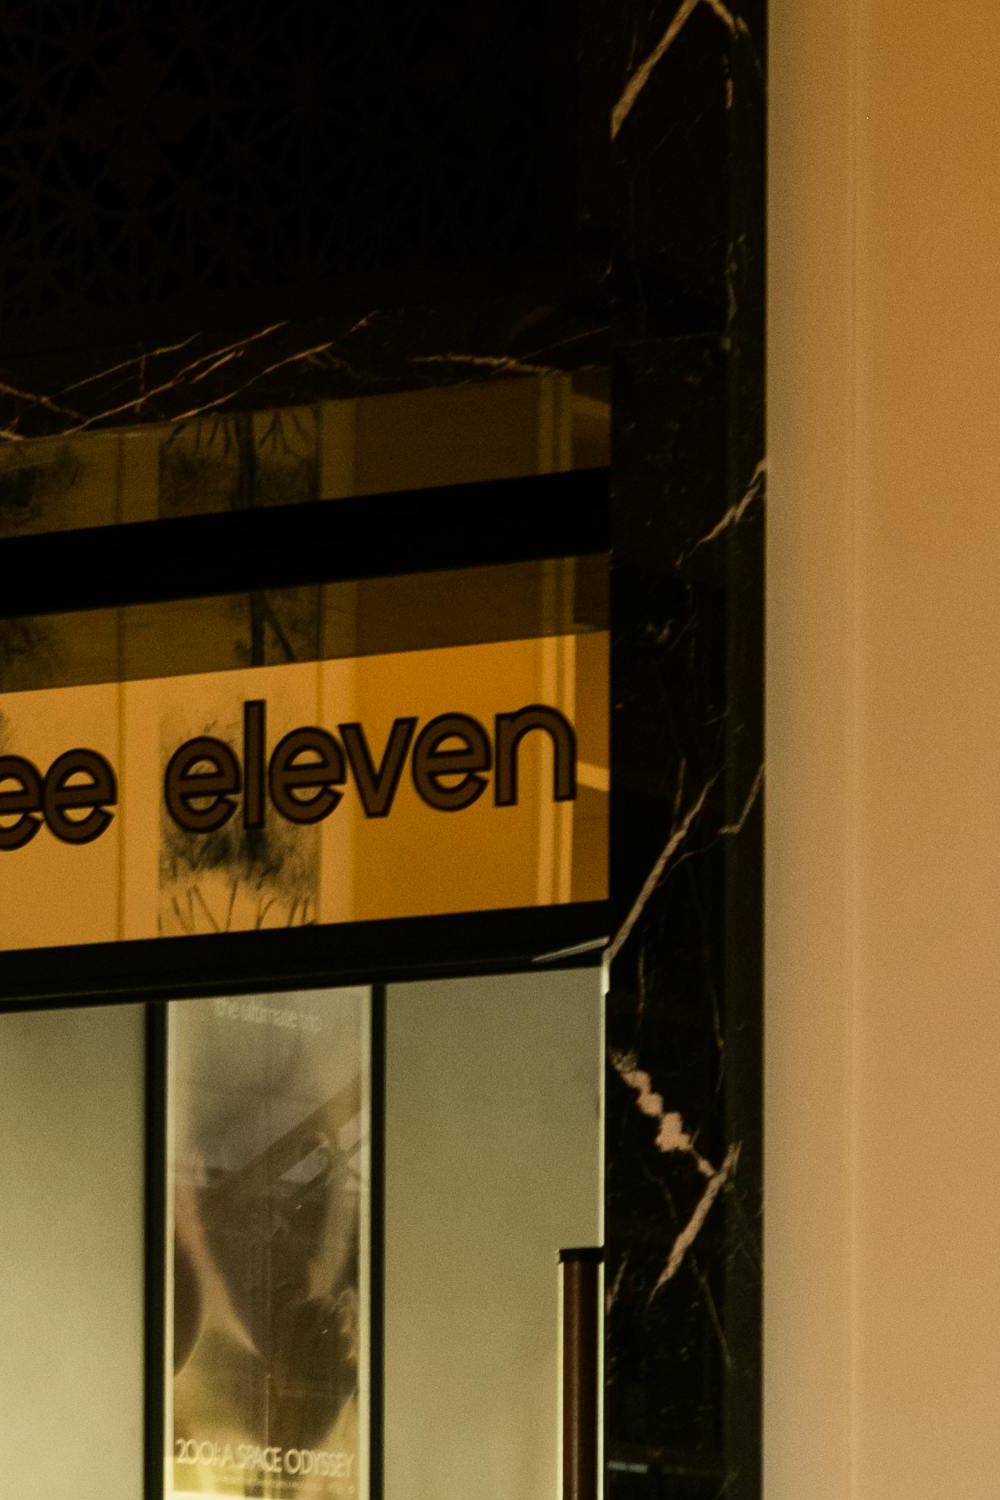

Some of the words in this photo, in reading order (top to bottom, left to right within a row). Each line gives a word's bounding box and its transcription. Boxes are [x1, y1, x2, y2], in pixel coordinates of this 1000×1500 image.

[164, 700, 577, 832] eleven
[233, 1443, 283, 1473] SPACE
[284, 1447, 355, 1477] ODYSSEY
